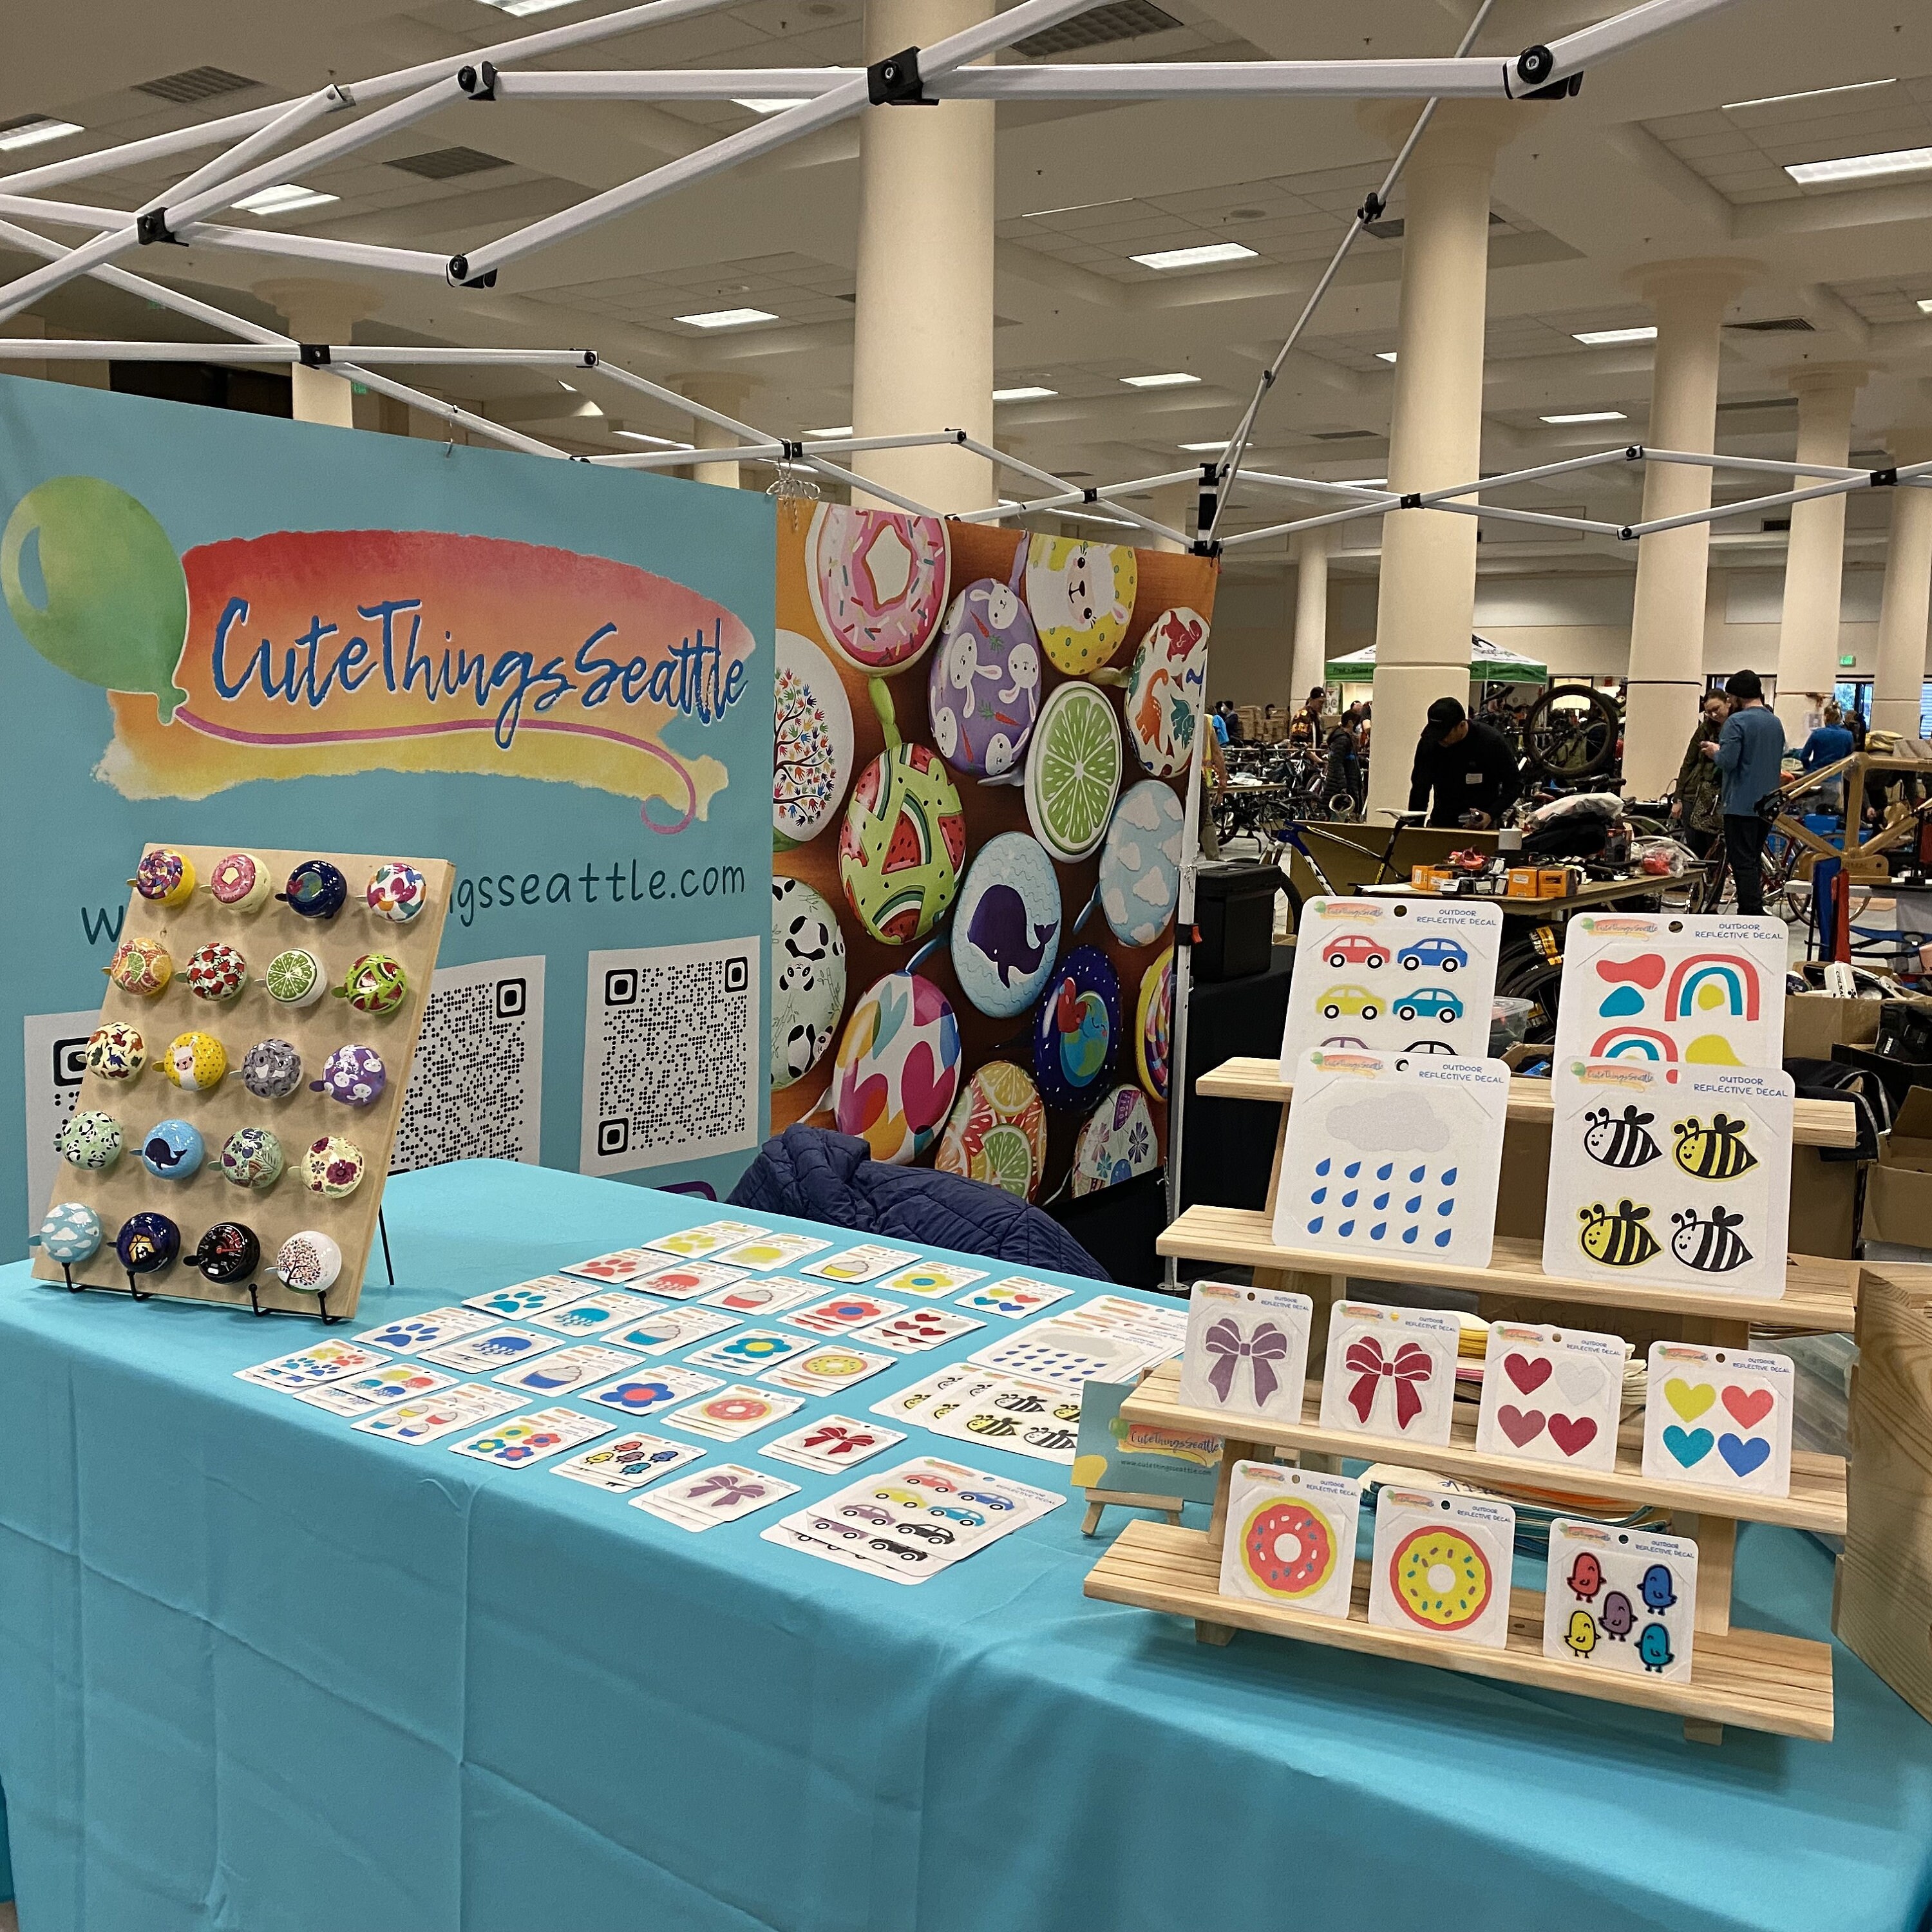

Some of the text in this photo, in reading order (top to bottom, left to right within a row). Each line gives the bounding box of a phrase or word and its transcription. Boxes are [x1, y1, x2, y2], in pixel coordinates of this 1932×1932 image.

[212, 596, 748, 748] CuteThingsSeattle
[449, 858, 746, 927] gsseattle.com
[1416, 916, 1466, 925] REFLECTIVE
[1695, 931, 1749, 939] REFLECTIVE
[1443, 1064, 1482, 1072] OUTDOOR
[1419, 1071, 1504, 1083] REFLECTIVE DECAL
[1719, 1075, 1764, 1086] OUTDOOR
[1694, 1083, 1788, 1097] REFLECTIVE DECAL
[1131, 1431, 1220, 1454] CuteThingsSeattle
